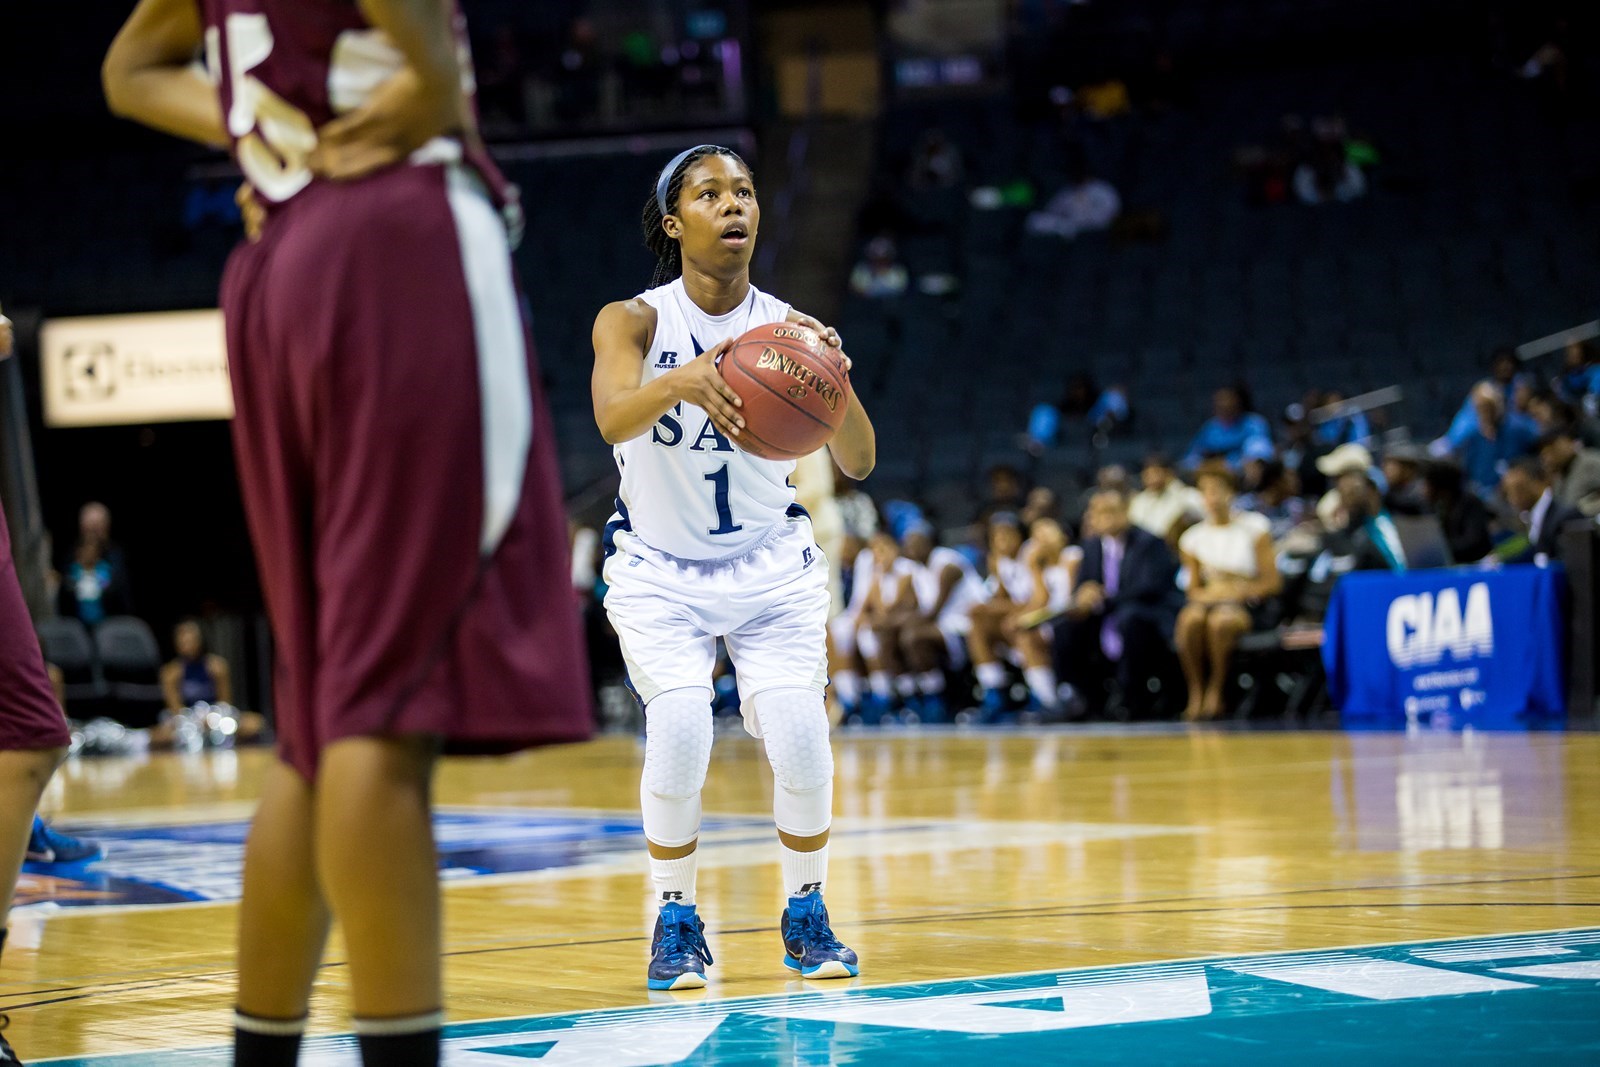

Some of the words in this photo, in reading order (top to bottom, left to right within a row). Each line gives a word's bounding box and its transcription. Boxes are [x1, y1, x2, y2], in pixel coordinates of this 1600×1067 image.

[756, 345, 842, 413] SPALDING
[651, 399, 736, 453] SA
[703, 462, 743, 535] 1
[1386, 581, 1494, 671] CIAA
